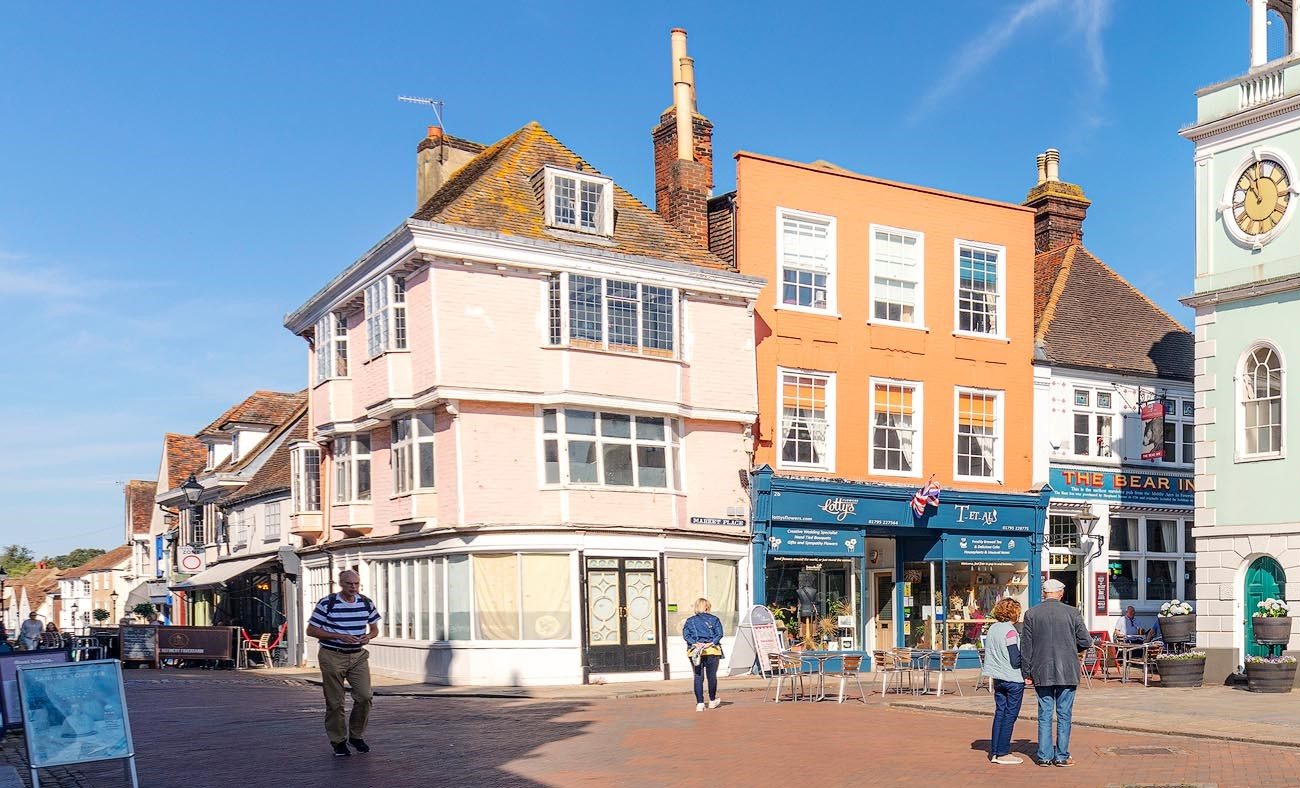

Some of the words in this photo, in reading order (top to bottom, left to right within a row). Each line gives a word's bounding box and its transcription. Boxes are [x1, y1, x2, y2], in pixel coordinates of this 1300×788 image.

[1062, 471, 1104, 488] THE
[1114, 474, 1171, 491] BEAR
[692, 517, 721, 525] MARKET
